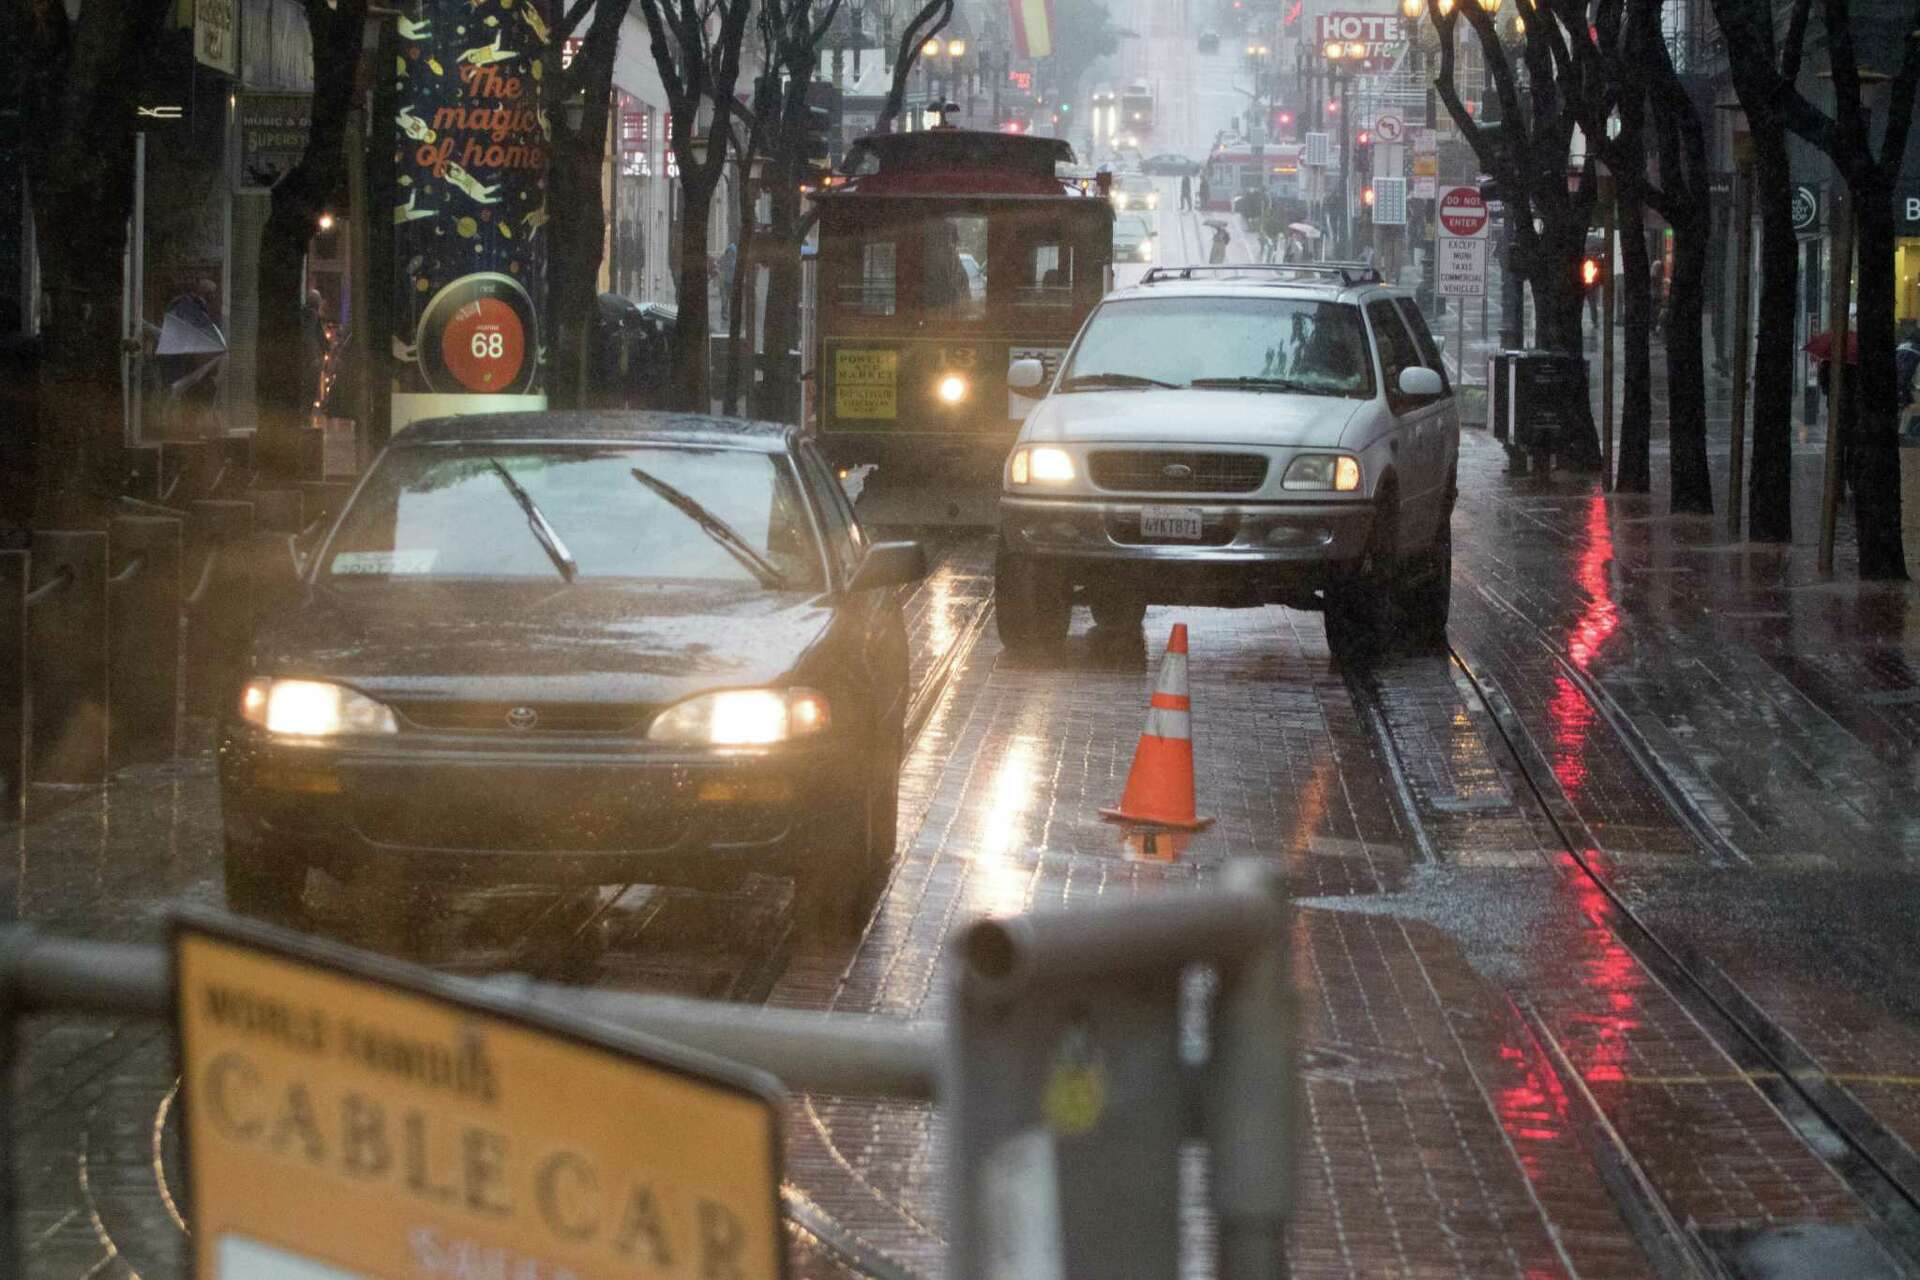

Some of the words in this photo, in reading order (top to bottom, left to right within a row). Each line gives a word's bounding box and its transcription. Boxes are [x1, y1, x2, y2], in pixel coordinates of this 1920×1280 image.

[459, 63, 521, 98] The
[243, 117, 282, 126] MUSIC
[433, 106, 537, 142] magic
[416, 137, 454, 178] of
[460, 138, 543, 168] home
[1447, 196, 1460, 206] DO
[1449, 218, 1478, 228] ENTER
[1448, 241, 1476, 249] EXCEPT
[1452, 263, 1473, 271] TAXIS
[471, 332, 504, 358] 68
[206, 1050, 512, 1218] CABLE
[534, 1148, 745, 1280] CAR
